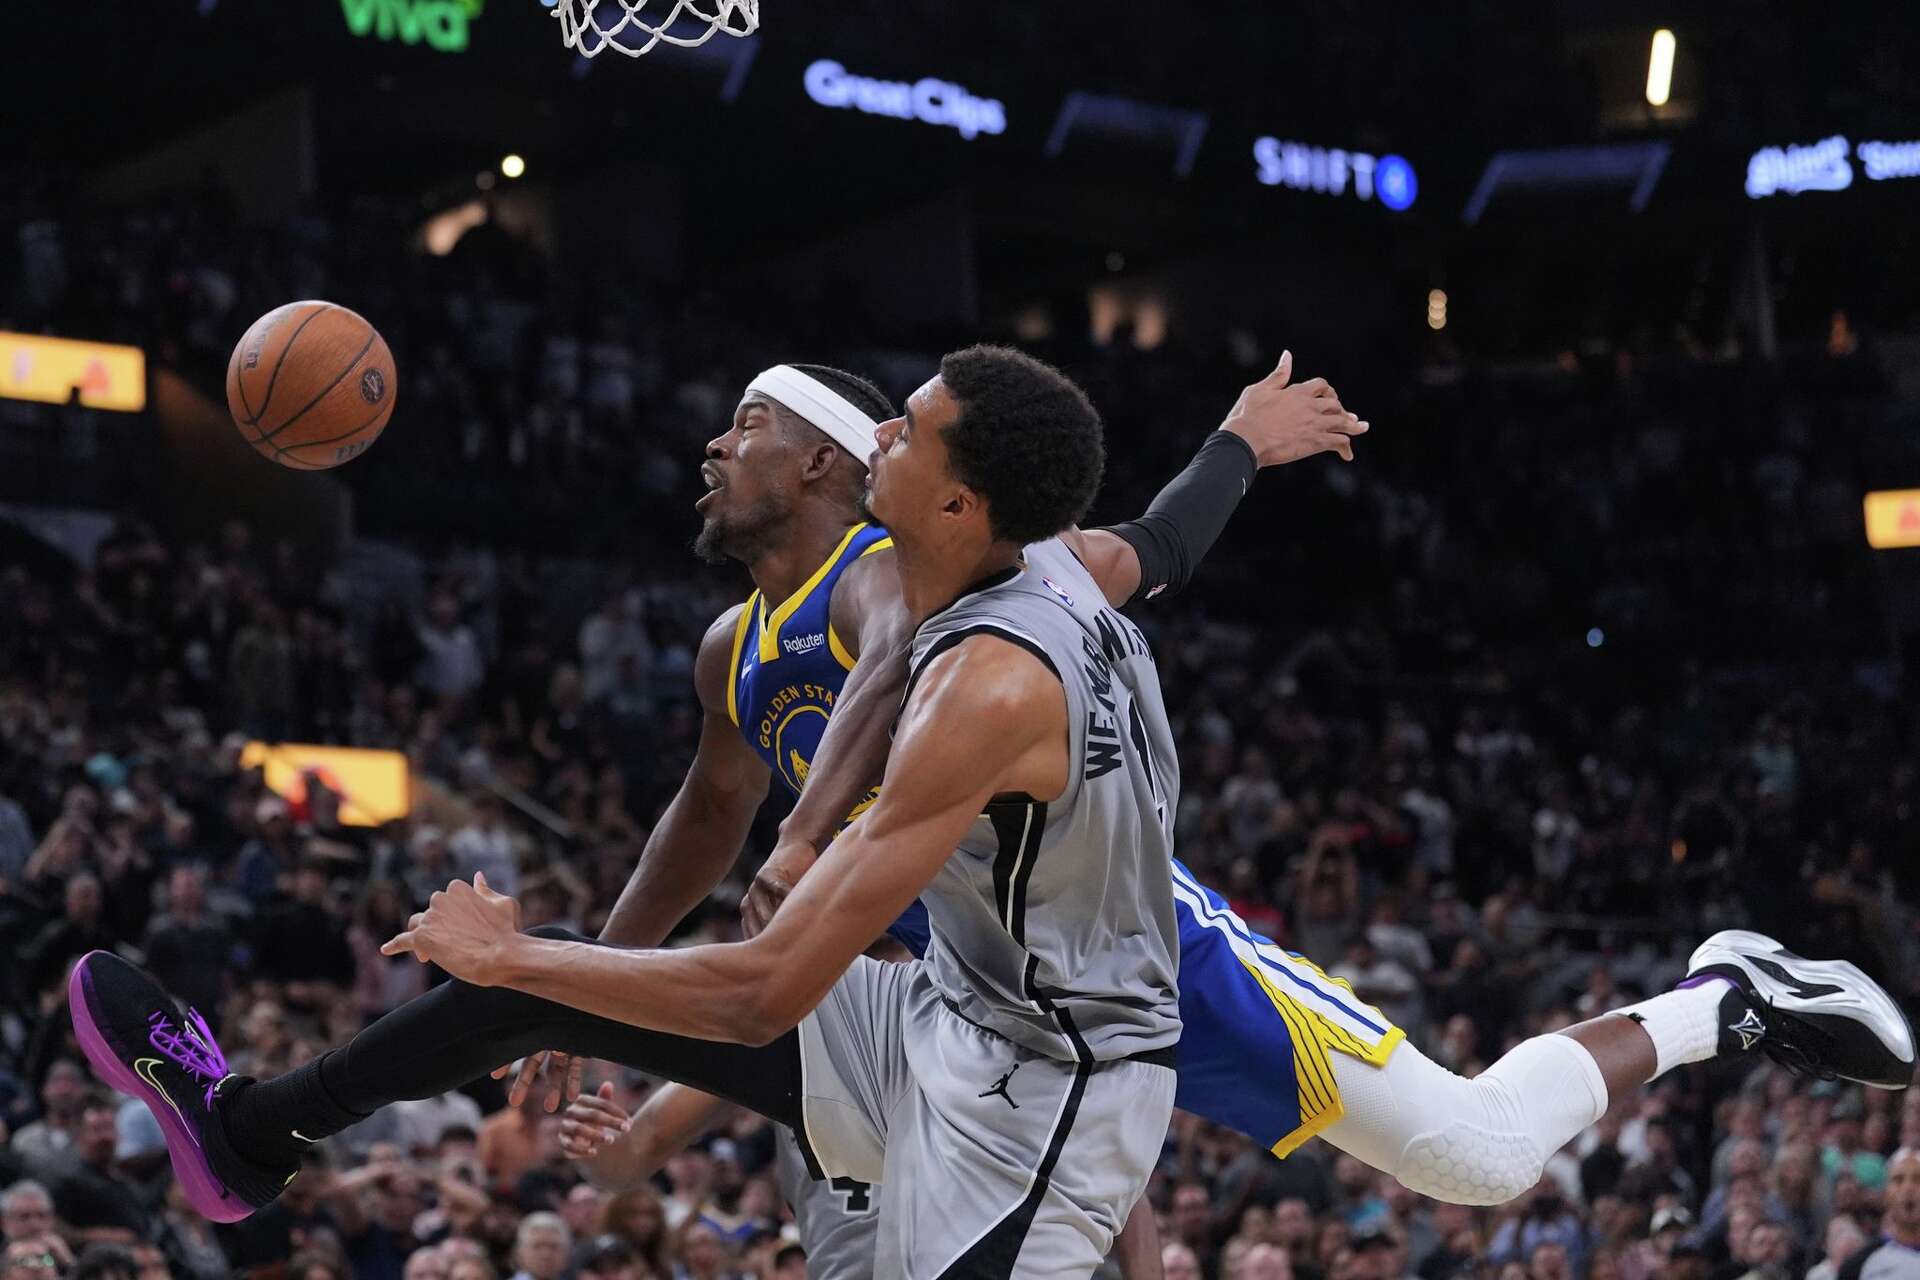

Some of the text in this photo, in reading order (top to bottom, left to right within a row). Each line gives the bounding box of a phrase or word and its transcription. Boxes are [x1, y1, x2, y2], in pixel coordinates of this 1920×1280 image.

[783, 633, 824, 653] Rakuten
[760, 684, 838, 749] GOLDEN STA
